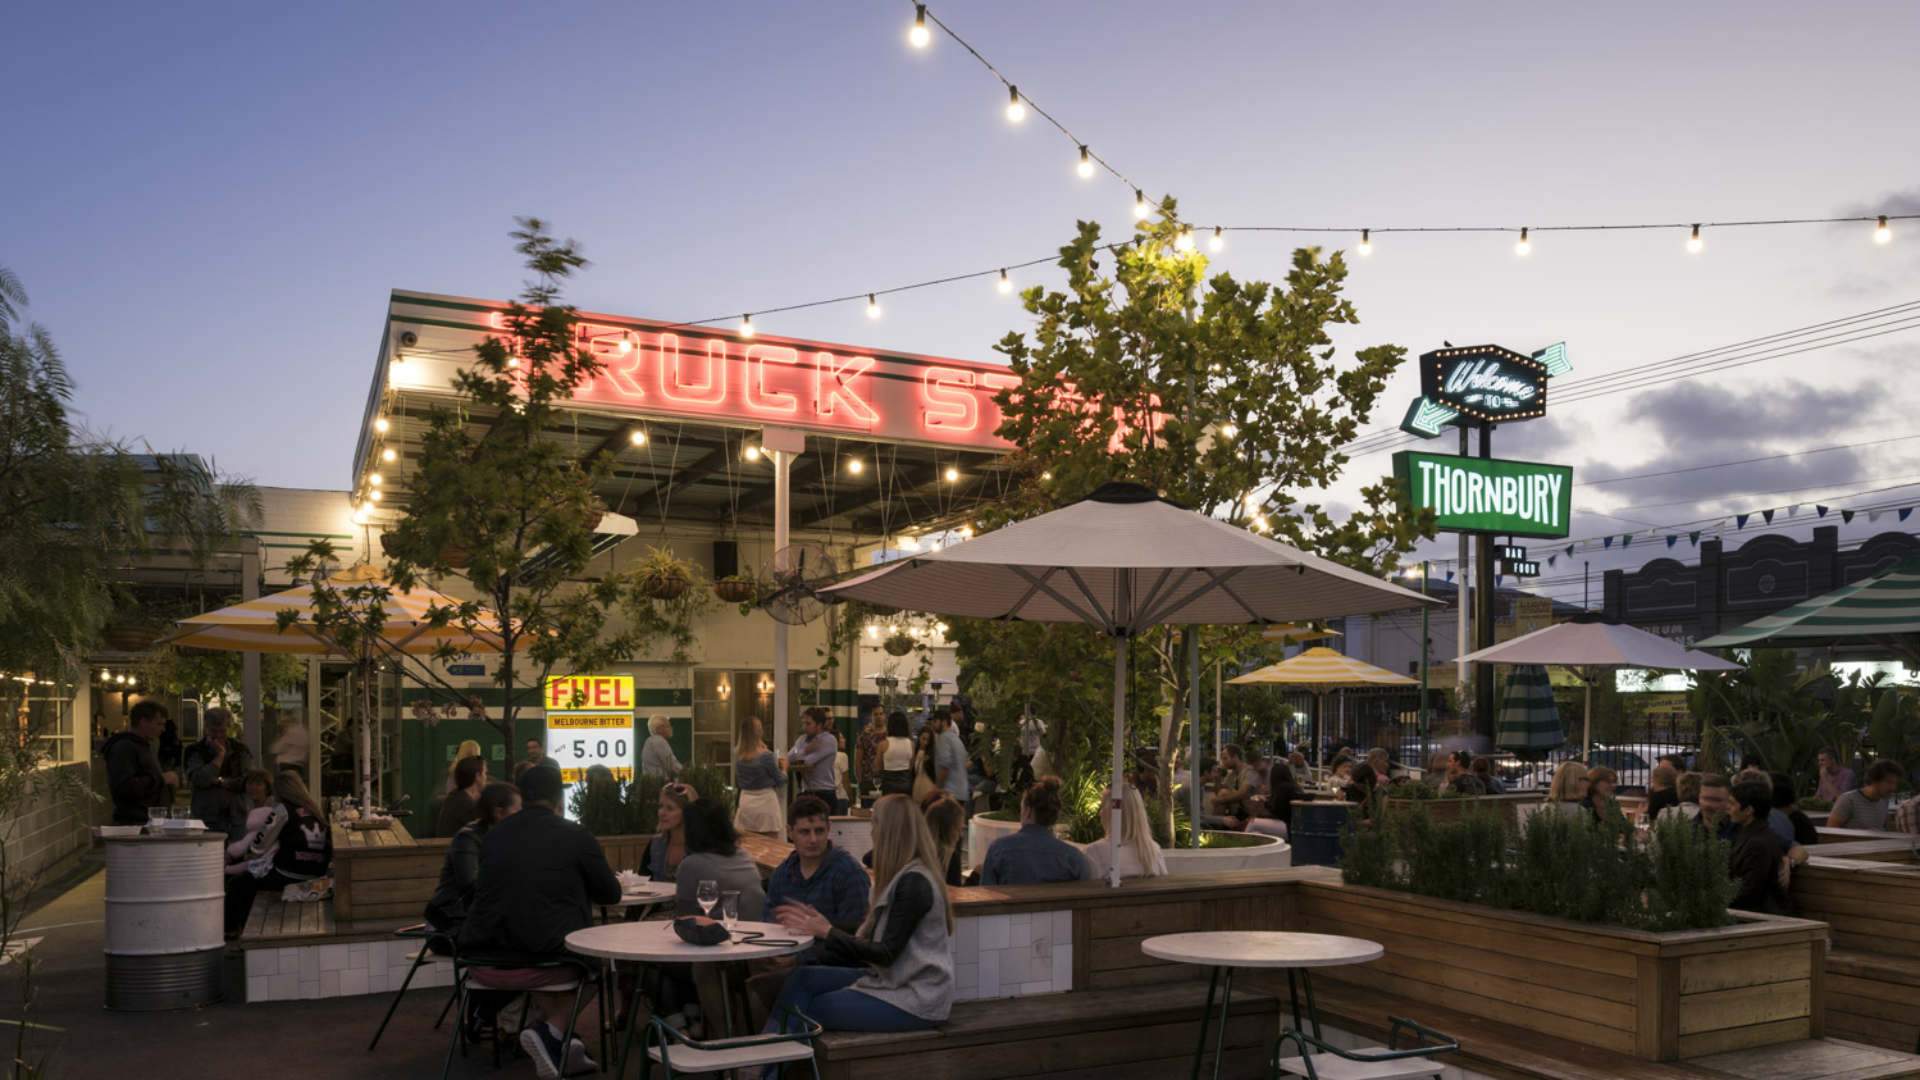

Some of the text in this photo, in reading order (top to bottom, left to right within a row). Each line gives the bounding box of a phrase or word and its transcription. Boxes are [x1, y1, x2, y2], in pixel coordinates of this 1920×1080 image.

[1445, 359, 1535, 400] Welcome
[1418, 461, 1562, 527] THORNBURY
[1513, 562, 1536, 575] FOOD
[551, 678, 630, 707] FUEL
[554, 718, 625, 726] MELBOURNE BITTER
[573, 739, 627, 759] 5.00
